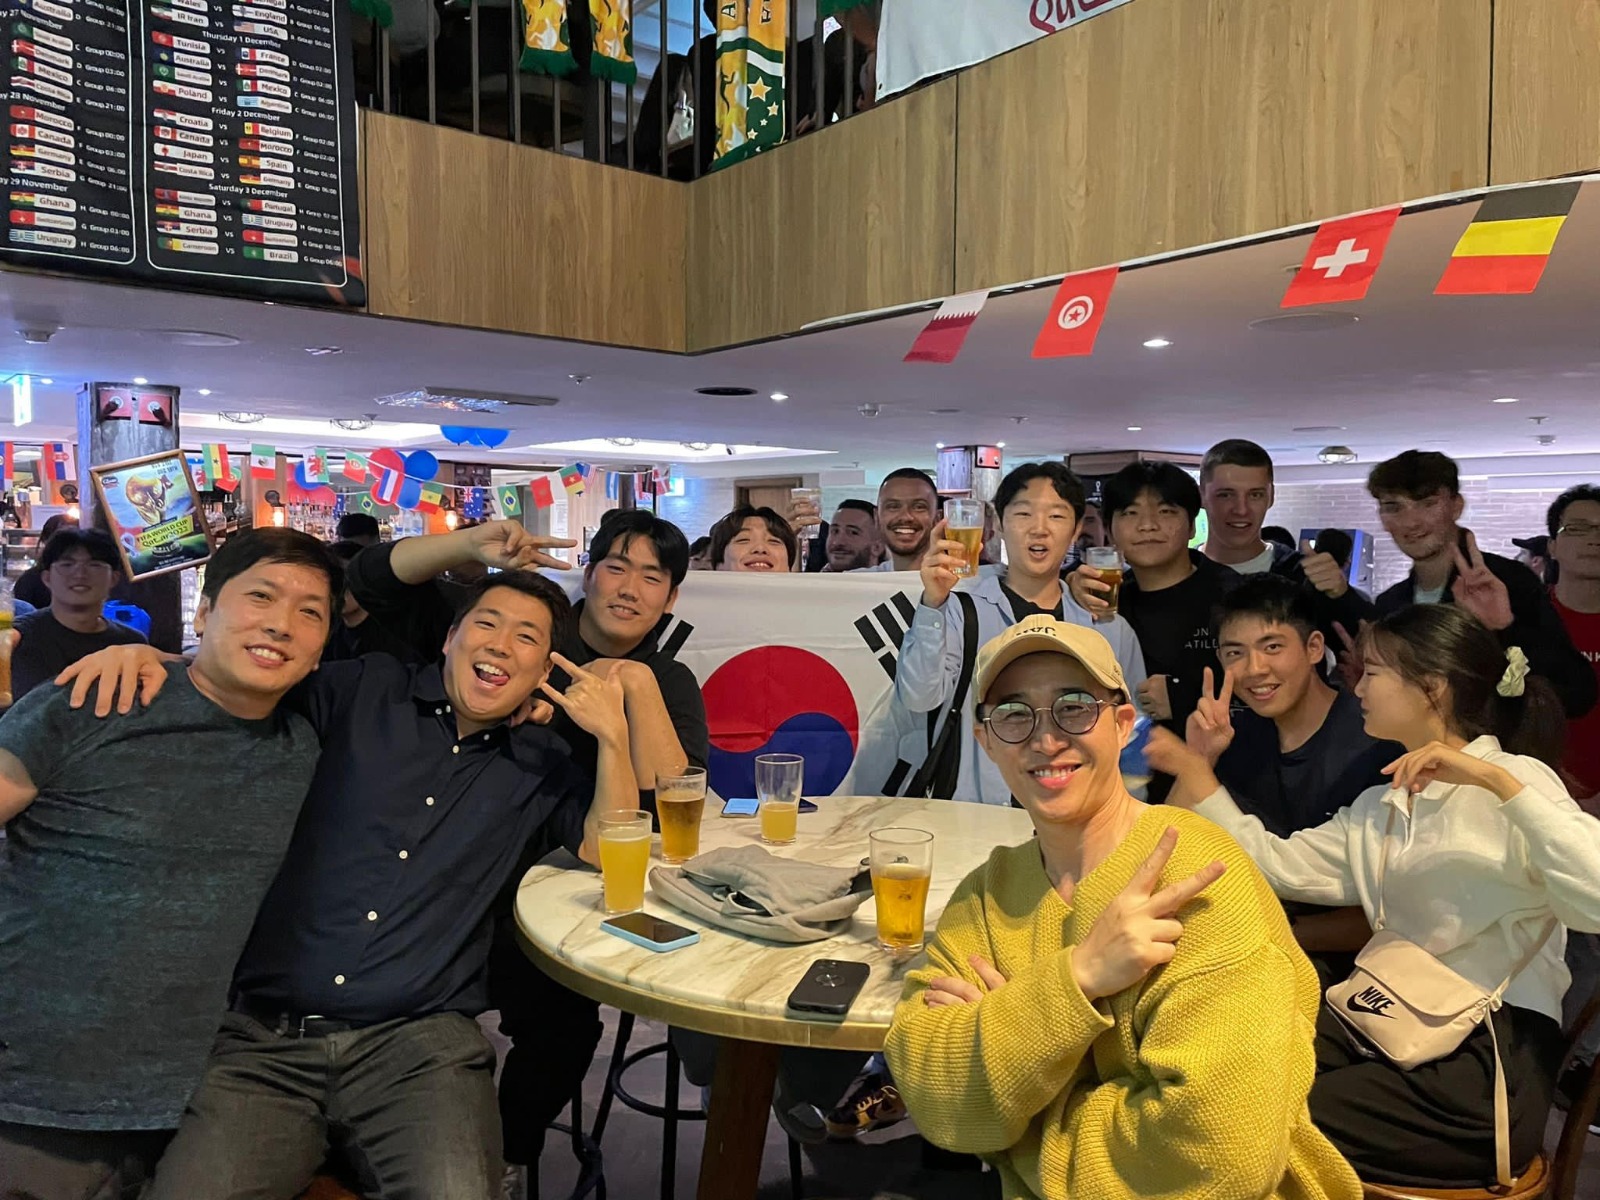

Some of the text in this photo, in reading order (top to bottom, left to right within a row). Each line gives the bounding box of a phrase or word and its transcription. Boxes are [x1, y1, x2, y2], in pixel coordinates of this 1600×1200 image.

[188, 16, 204, 24] Iran
[255, 10, 286, 22] England
[264, 26, 278, 36] USA
[202, 31, 238, 43] Thursday
[244, 36, 281, 48] December
[177, 40, 206, 50] Tunisia
[260, 52, 286, 62] France
[176, 55, 210, 66] Australia
[38, 66, 68, 82] Mexico
[178, 88, 208, 99] Poland
[262, 84, 288, 94] Mexico
[22, 93, 66, 111] November
[36, 112, 72, 128] Morocco
[212, 107, 236, 118] Friday
[244, 111, 280, 121] December
[180, 116, 208, 126] Croatia
[260, 126, 292, 137] Belgium
[38, 131, 72, 144] Canada
[180, 132, 210, 144] Canada
[260, 144, 292, 153] Morocco
[38, 147, 72, 162] Germany
[184, 150, 208, 160] Japan
[266, 160, 288, 169] Spain
[41, 166, 70, 178] Serbia
[22, 178, 68, 192] November
[208, 184, 244, 194] Saturday
[252, 188, 288, 198] December
[40, 198, 70, 208] Ghana
[264, 202, 293, 212] Portugal
[184, 210, 212, 218] Ghana
[264, 219, 294, 228] Uruguay
[186, 226, 213, 235] Serbia
[37, 234, 72, 245] Uruguay
[182, 243, 216, 251] Cameroon
[270, 252, 292, 260] Brazil
[152, 524, 176, 536] WORLD
[176, 519, 188, 528] CUP
[1358, 986, 1396, 1012] NIKE
